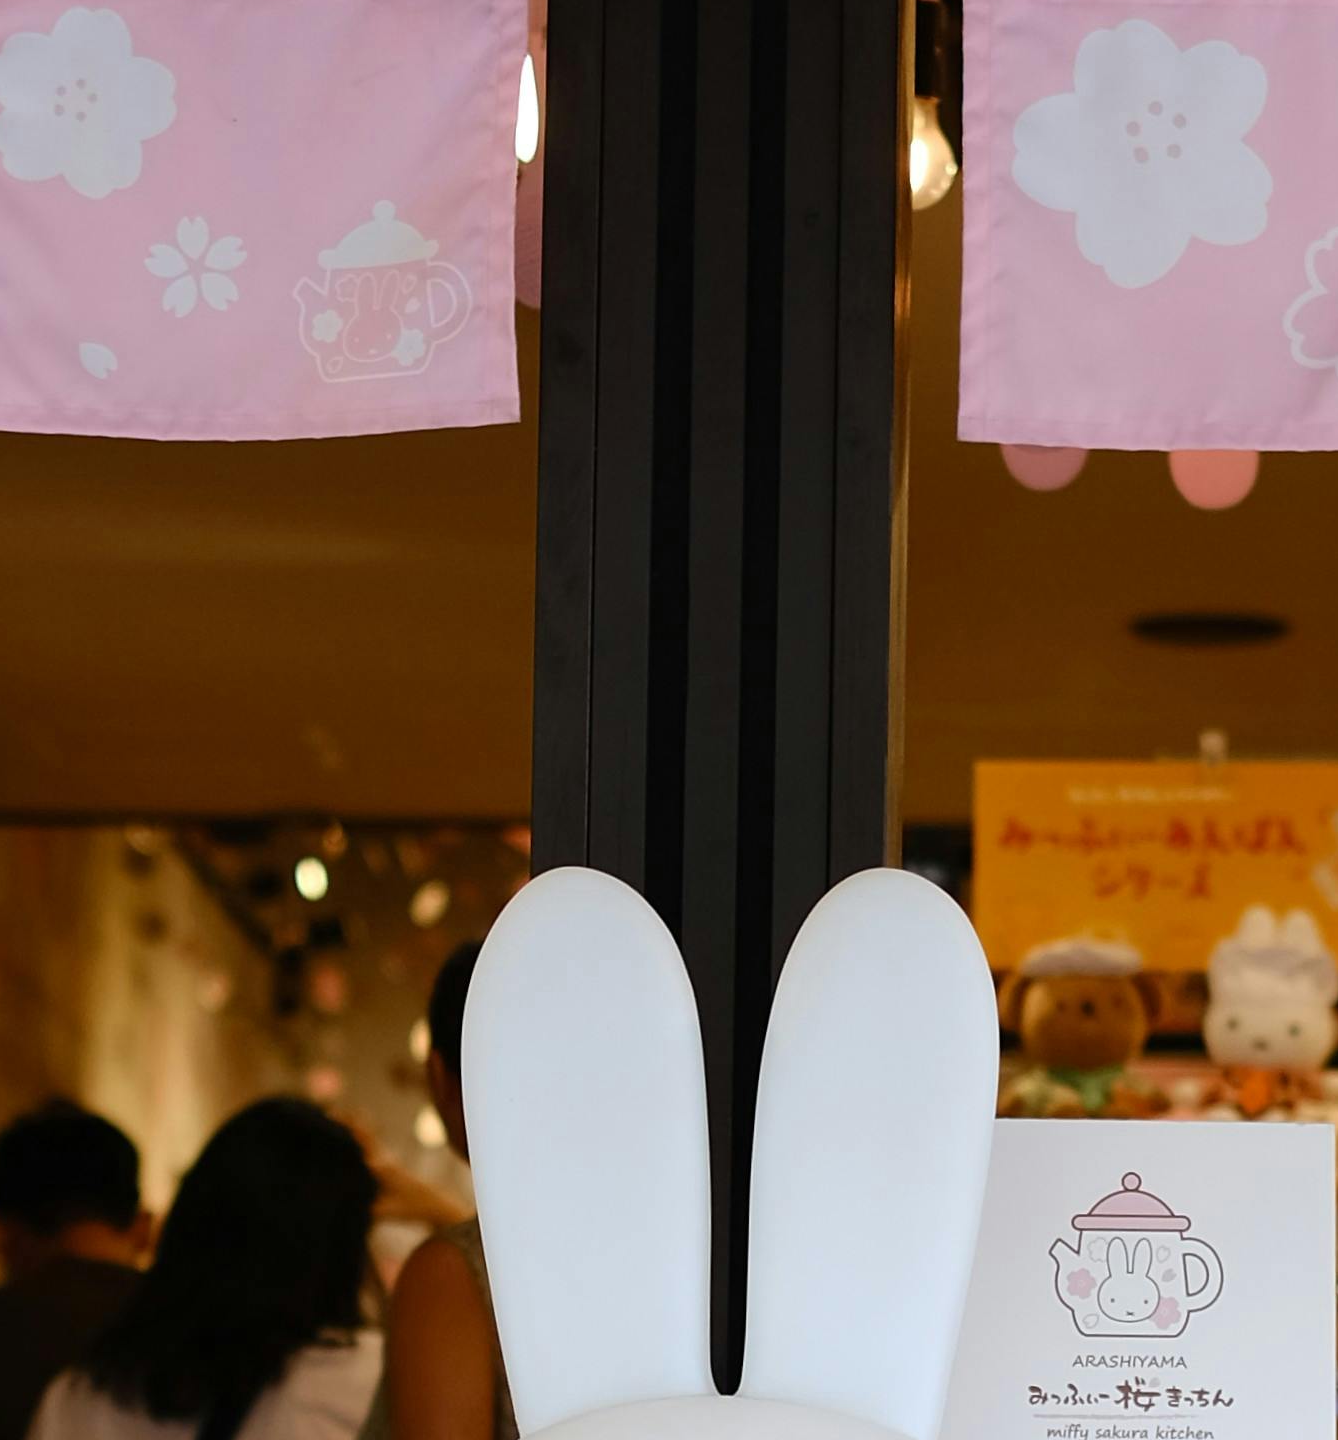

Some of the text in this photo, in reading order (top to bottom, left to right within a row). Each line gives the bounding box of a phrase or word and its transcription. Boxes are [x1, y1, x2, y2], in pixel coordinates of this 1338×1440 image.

[1072, 1355, 1187, 1369] ARASHIYAMA
[1028, 1376, 1234, 1412] みっふぃー桜きっちん
[1095, 1425, 1148, 1440] sakura
[1155, 1425, 1215, 1440] kitchen
